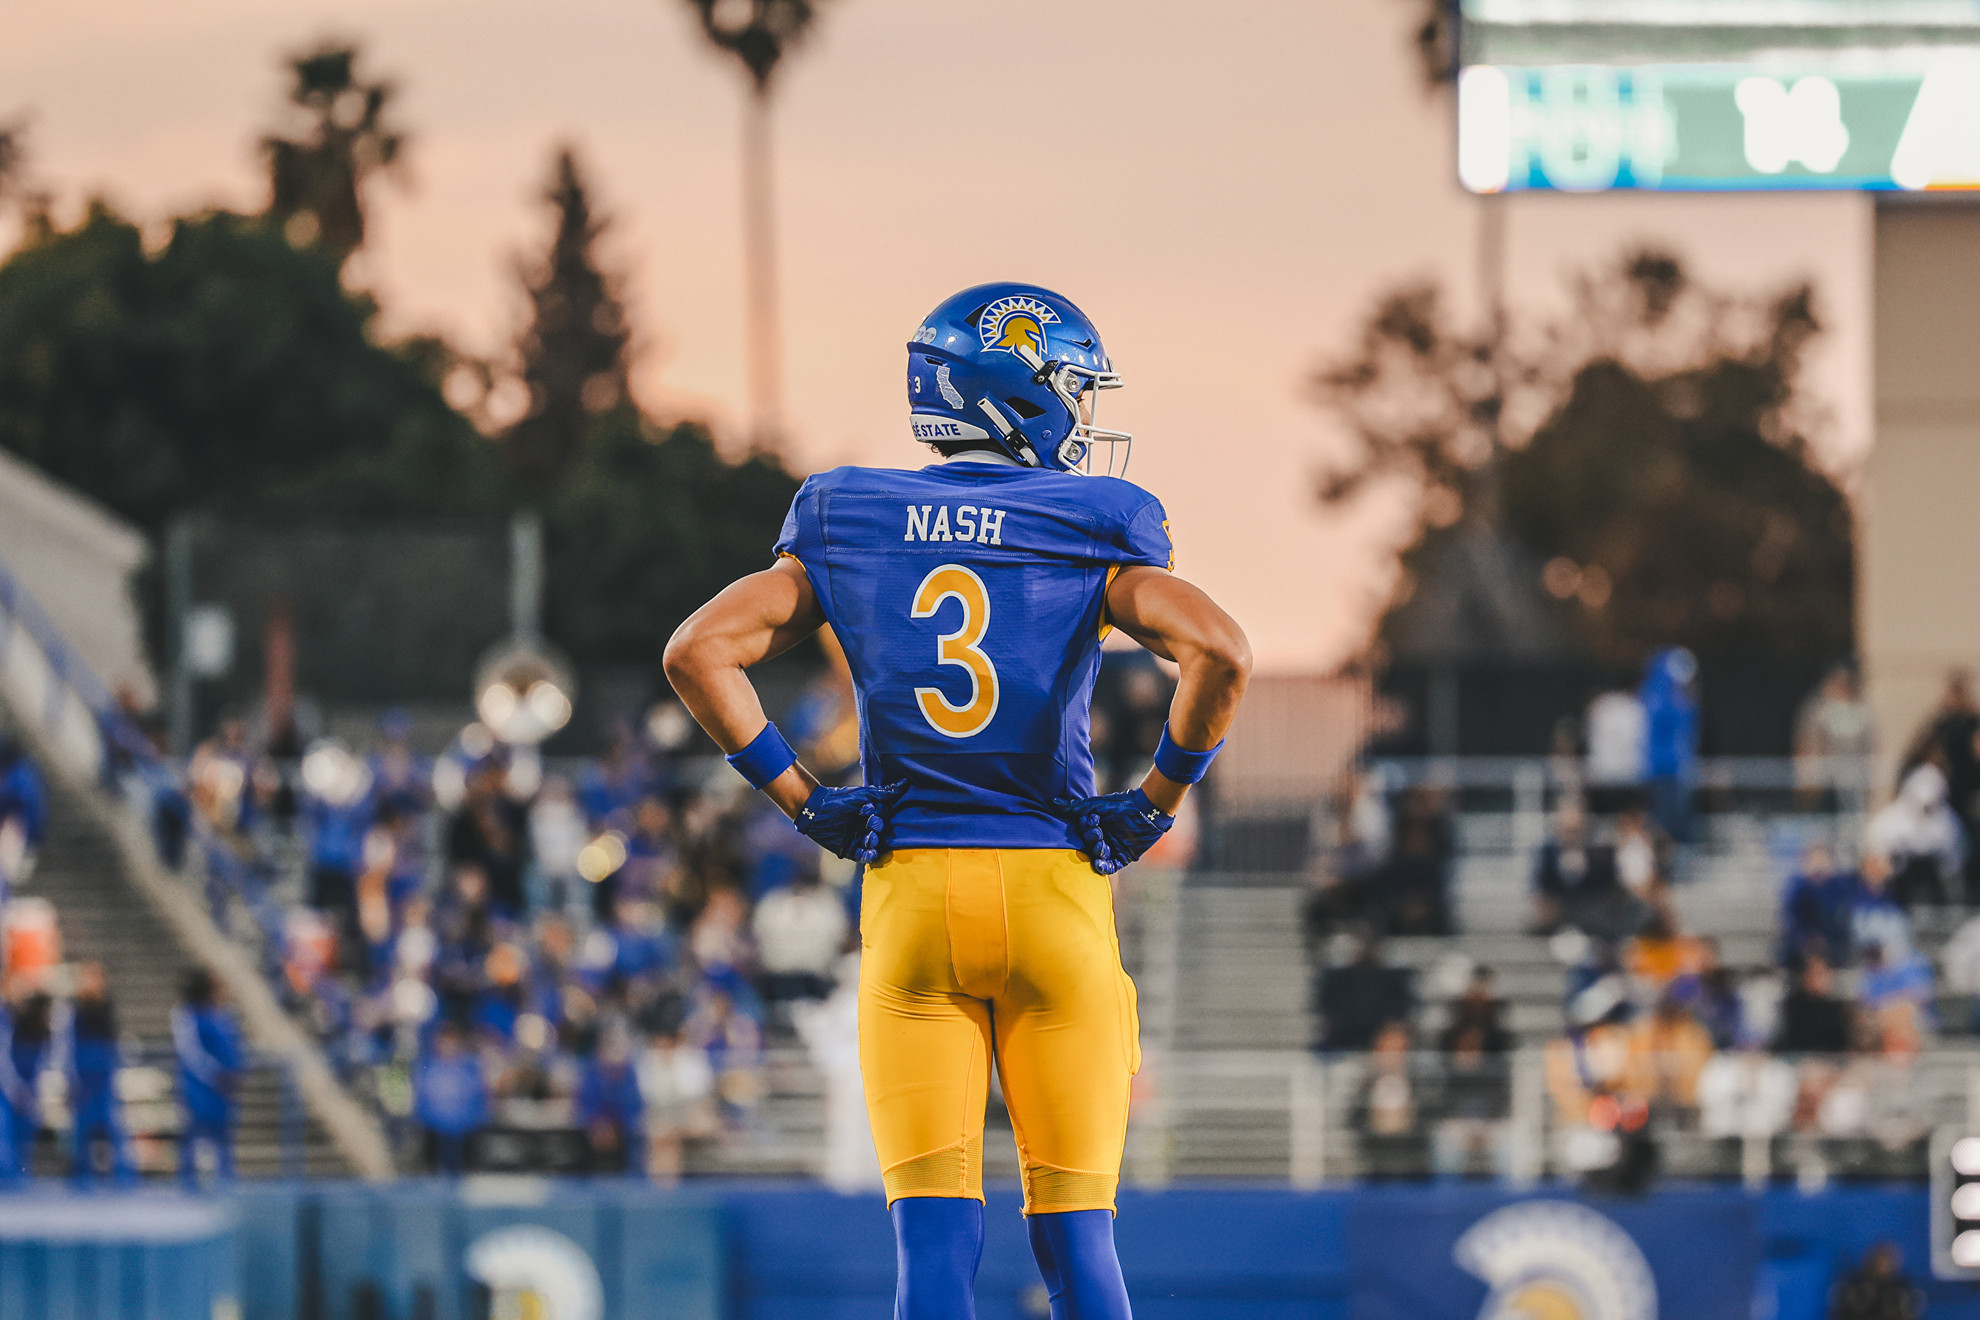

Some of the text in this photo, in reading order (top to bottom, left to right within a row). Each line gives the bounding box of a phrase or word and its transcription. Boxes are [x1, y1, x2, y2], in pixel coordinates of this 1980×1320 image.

[914, 376, 921, 394] 3
[920, 423, 961, 437] STATE
[904, 504, 1006, 546] NASH
[910, 563, 1000, 739] 3
